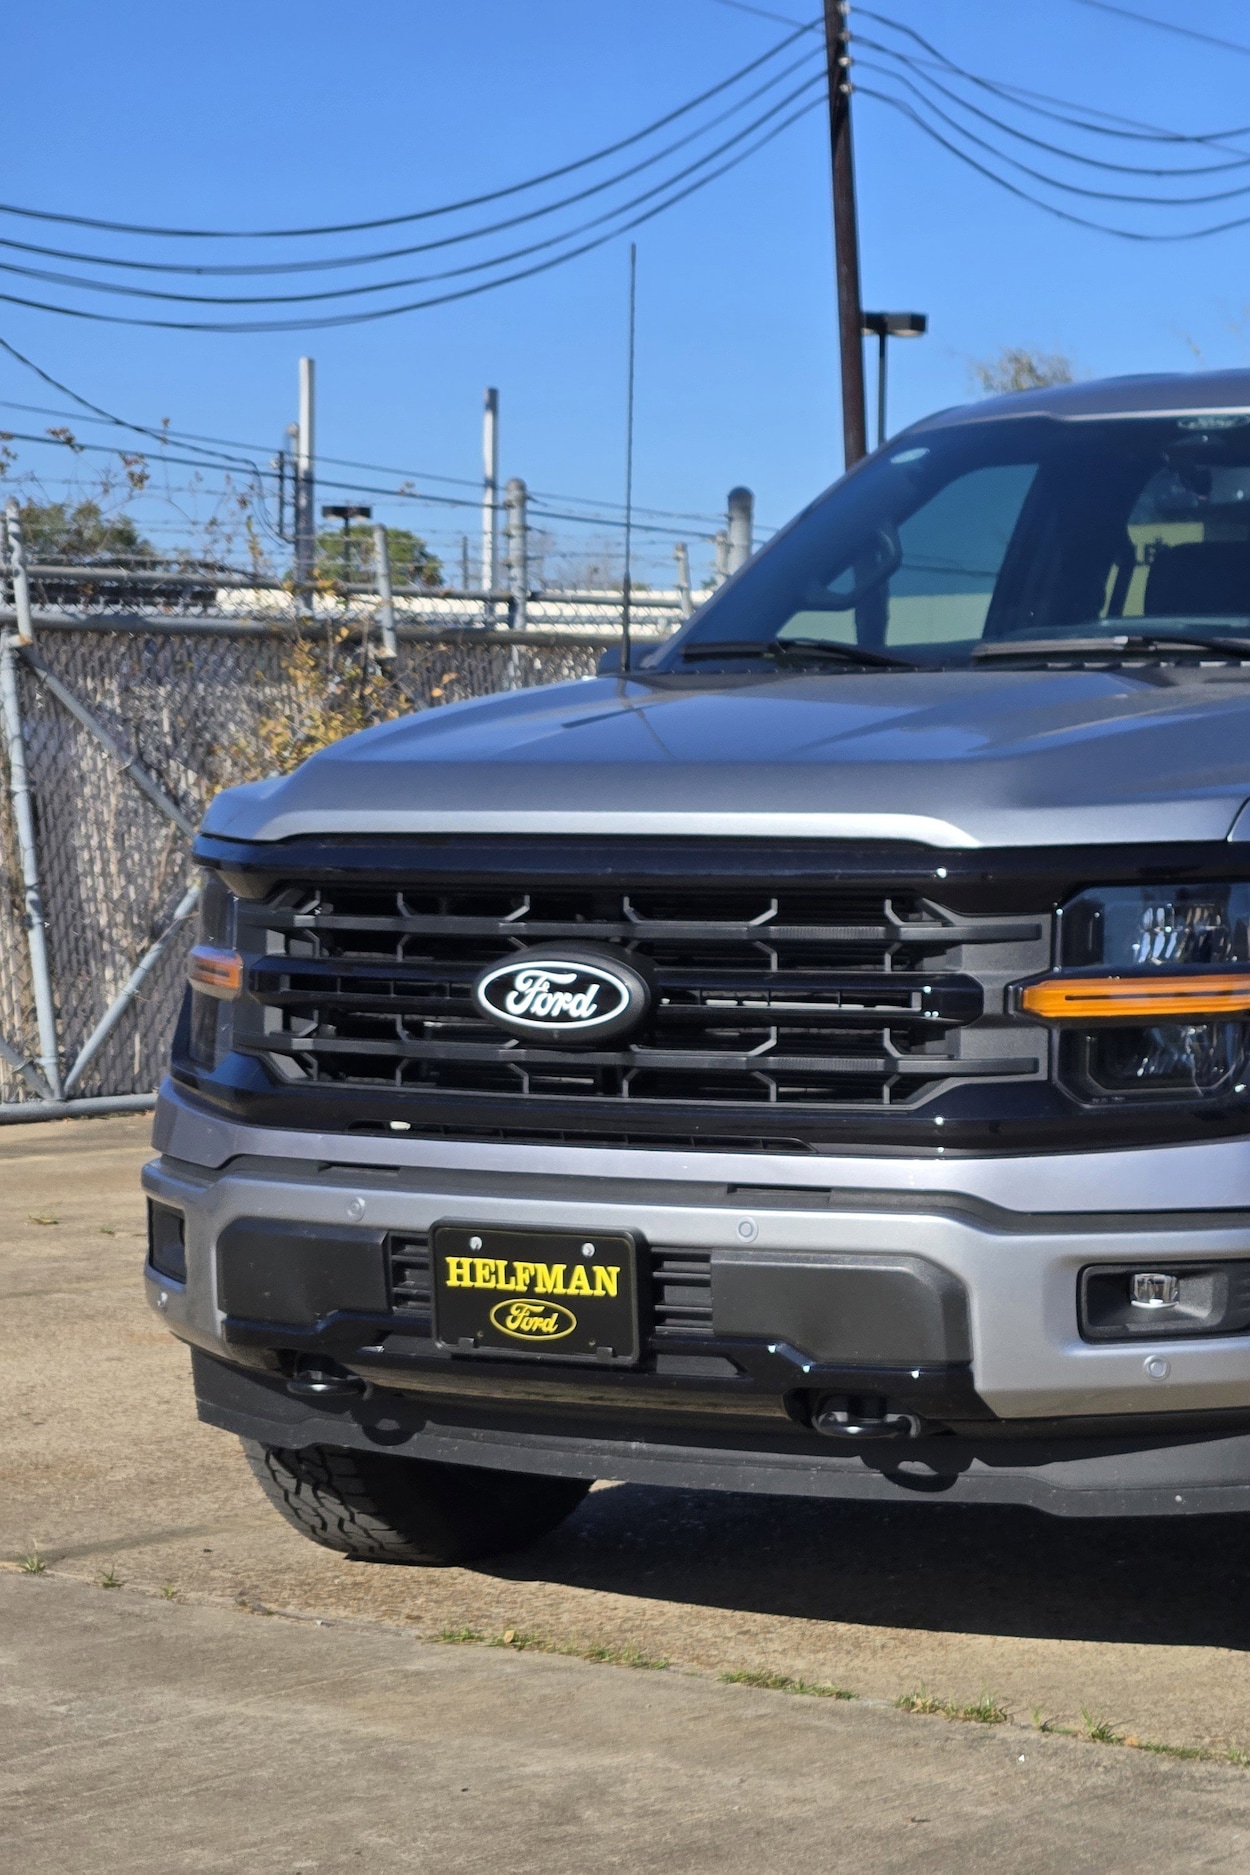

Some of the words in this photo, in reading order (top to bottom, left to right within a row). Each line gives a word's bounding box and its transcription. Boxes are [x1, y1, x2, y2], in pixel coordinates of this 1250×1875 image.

[505, 969, 600, 1018] Ford
[445, 1256, 621, 1297] HELFMAN
[505, 1302, 558, 1333] Ford
